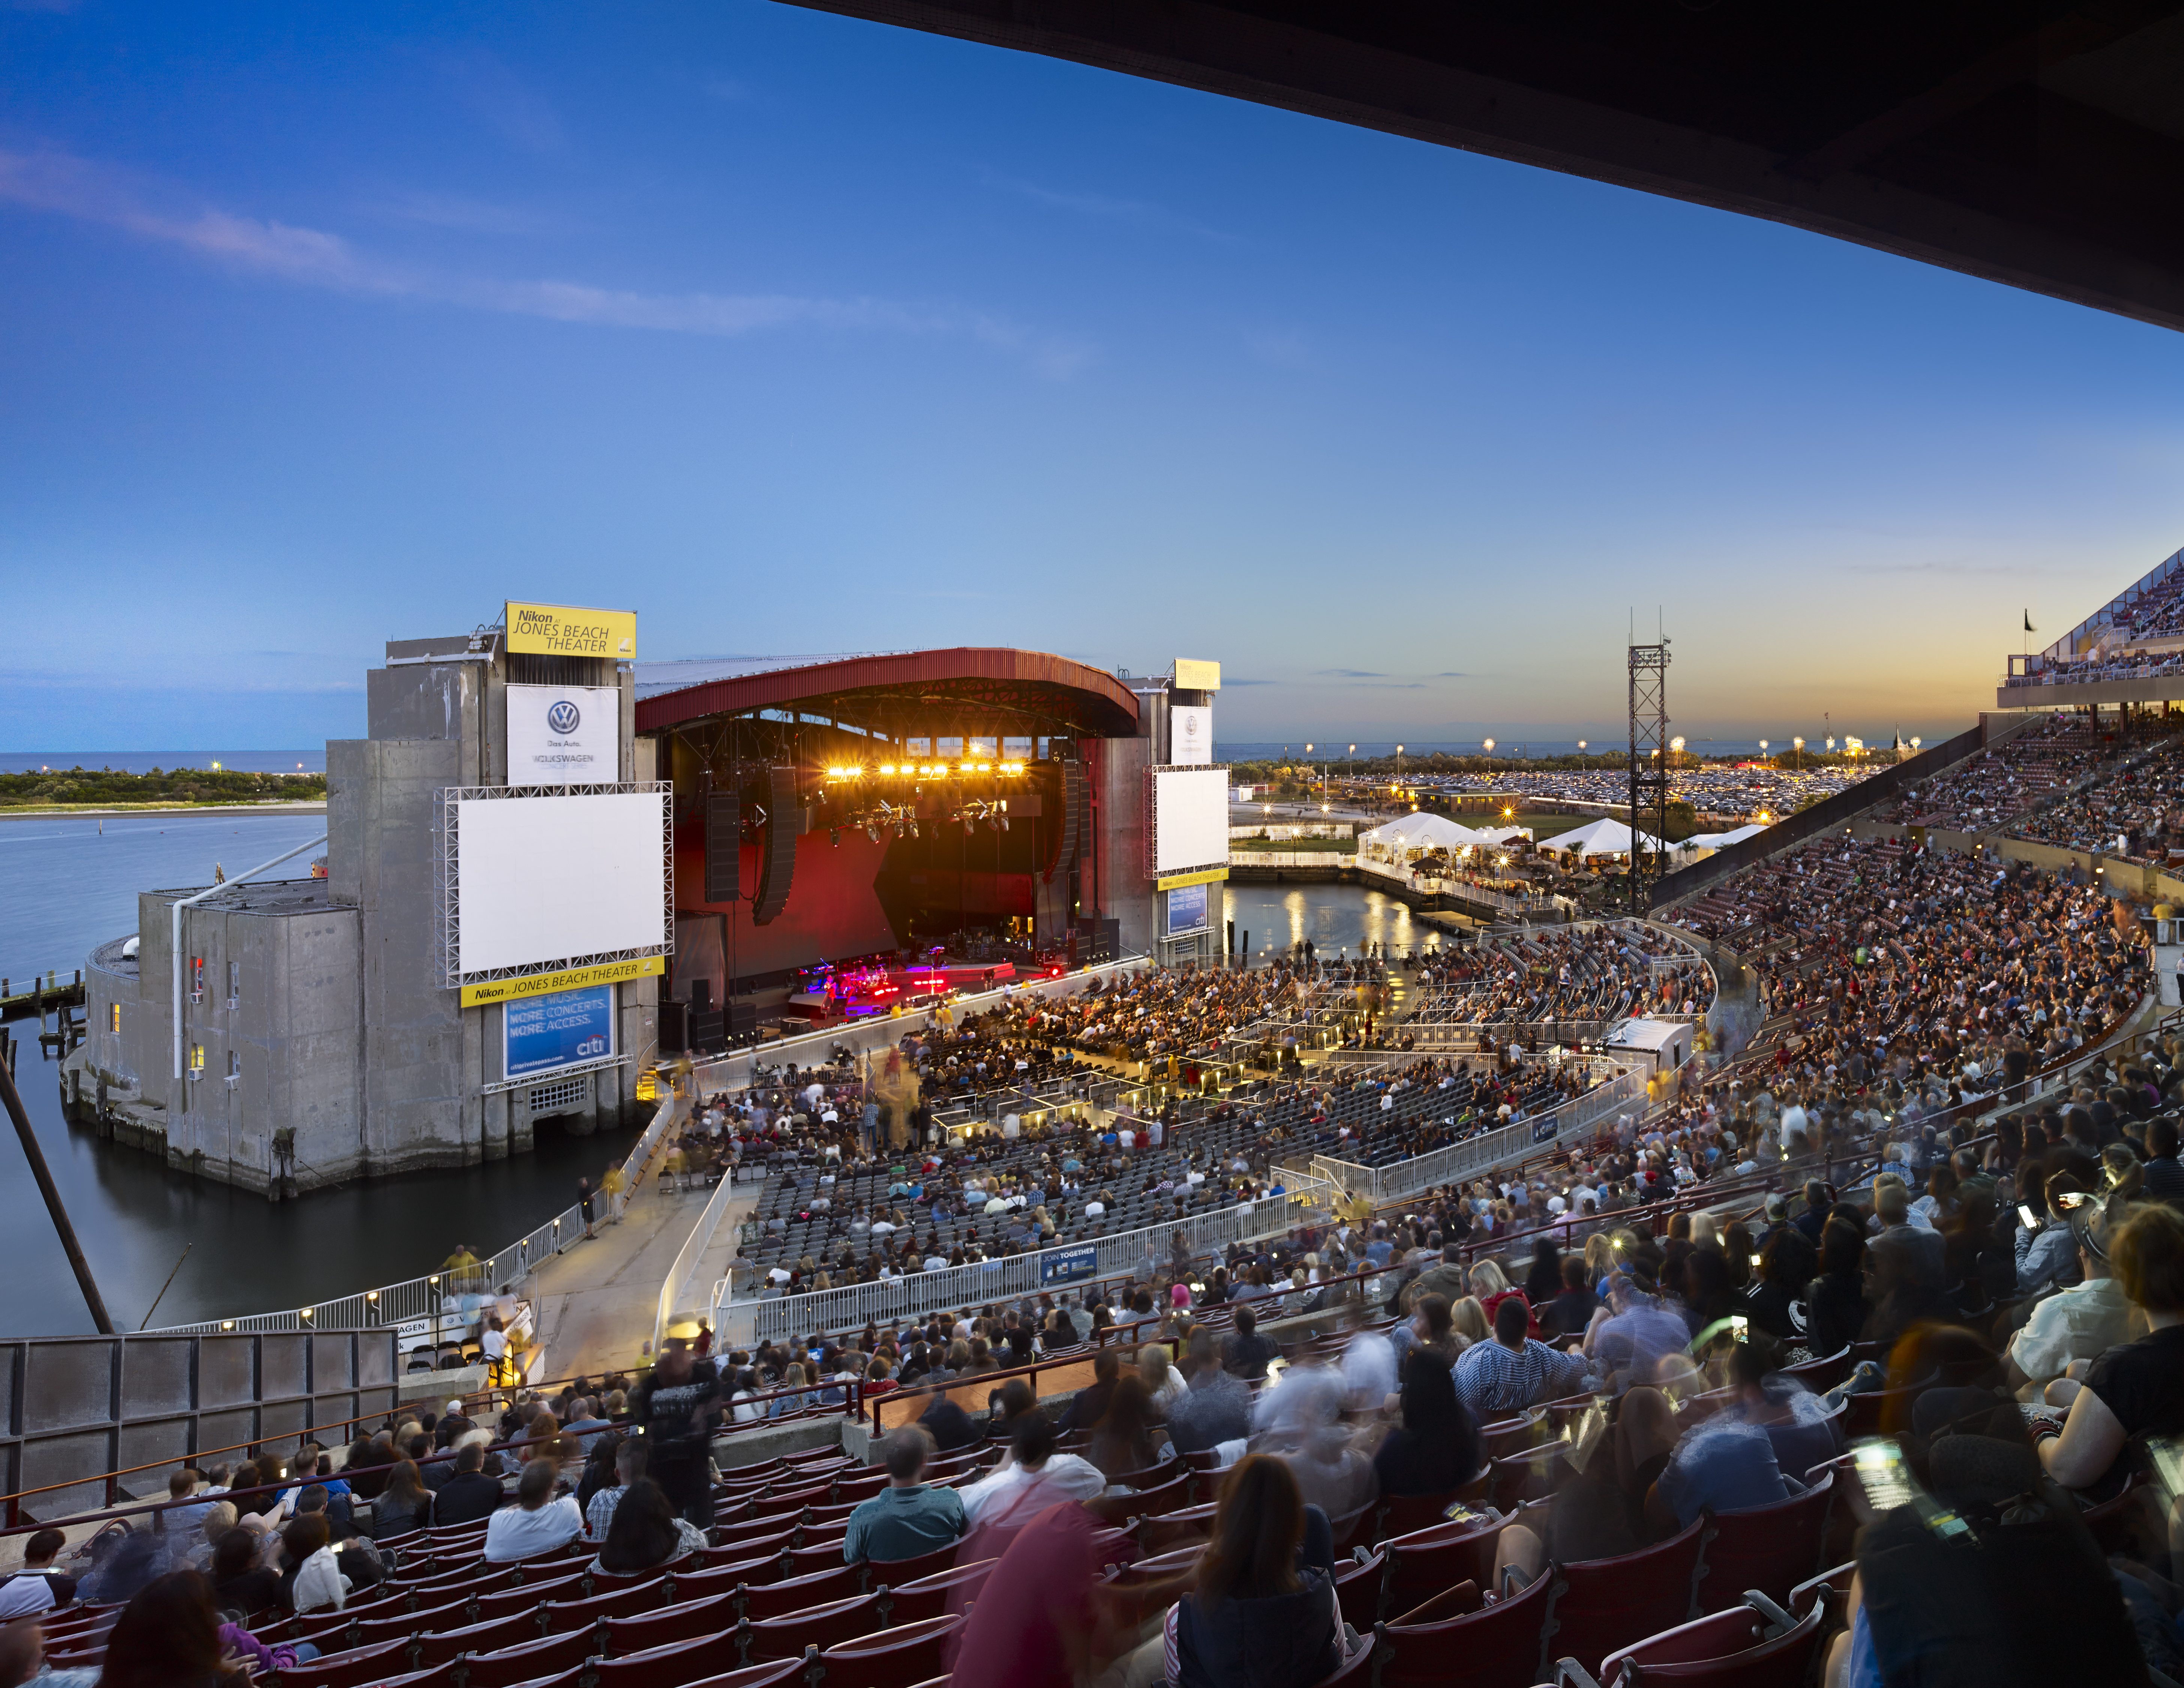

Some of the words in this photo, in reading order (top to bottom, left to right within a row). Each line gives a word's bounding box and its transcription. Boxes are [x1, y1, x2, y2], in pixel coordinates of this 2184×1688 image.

[518, 610, 552, 623] Nikon
[513, 622, 559, 636] JONES
[563, 625, 609, 639] BEACH
[546, 637, 607, 652] THEATER
[1189, 678, 1210, 686] THEATER
[1195, 915, 1205, 926] citi
[475, 987, 503, 1000] Nikon
[512, 978, 548, 994] JONES
[552, 972, 588, 987] BEACH
[592, 964, 637, 981] THEATER
[510, 998, 545, 1012] MORE
[546, 991, 585, 1005] MUSIC.
[510, 1010, 546, 1024] MORE
[546, 999, 607, 1017] CONCERTS.
[510, 1023, 547, 1038] MORE
[546, 1014, 593, 1031] ACCESS.
[576, 1038, 604, 1056] citi
[510, 1055, 564, 1070] citiprivatepass.com
[1043, 1254, 1060, 1263] JOIN
[1060, 1247, 1094, 1259] TOGETHER
